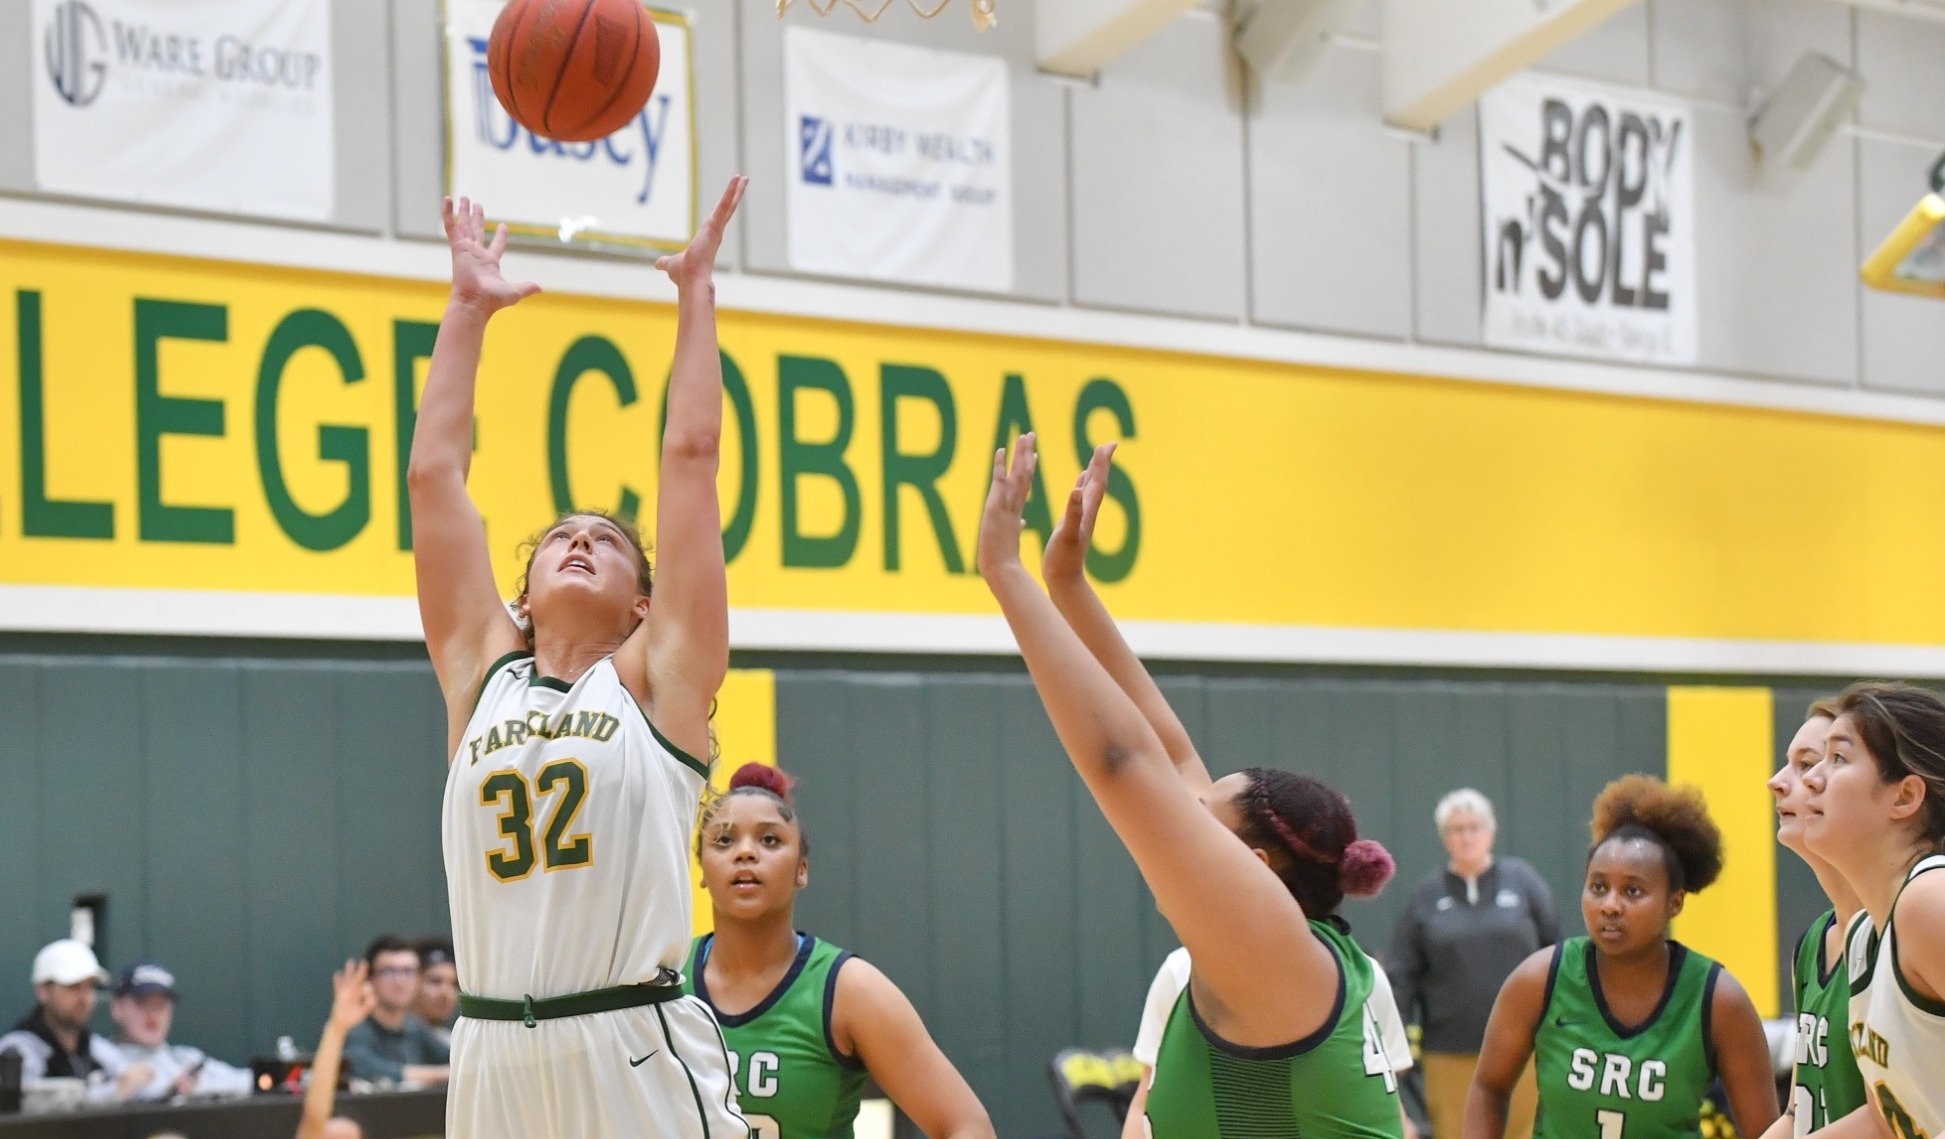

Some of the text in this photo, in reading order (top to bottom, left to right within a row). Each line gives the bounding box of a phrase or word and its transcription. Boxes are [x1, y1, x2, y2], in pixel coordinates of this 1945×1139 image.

[546, 334, 1140, 584] COBRAS
[479, 757, 593, 883] 32
[1567, 1047, 1667, 1102] SRC
[1797, 1012, 1829, 1069] RC
